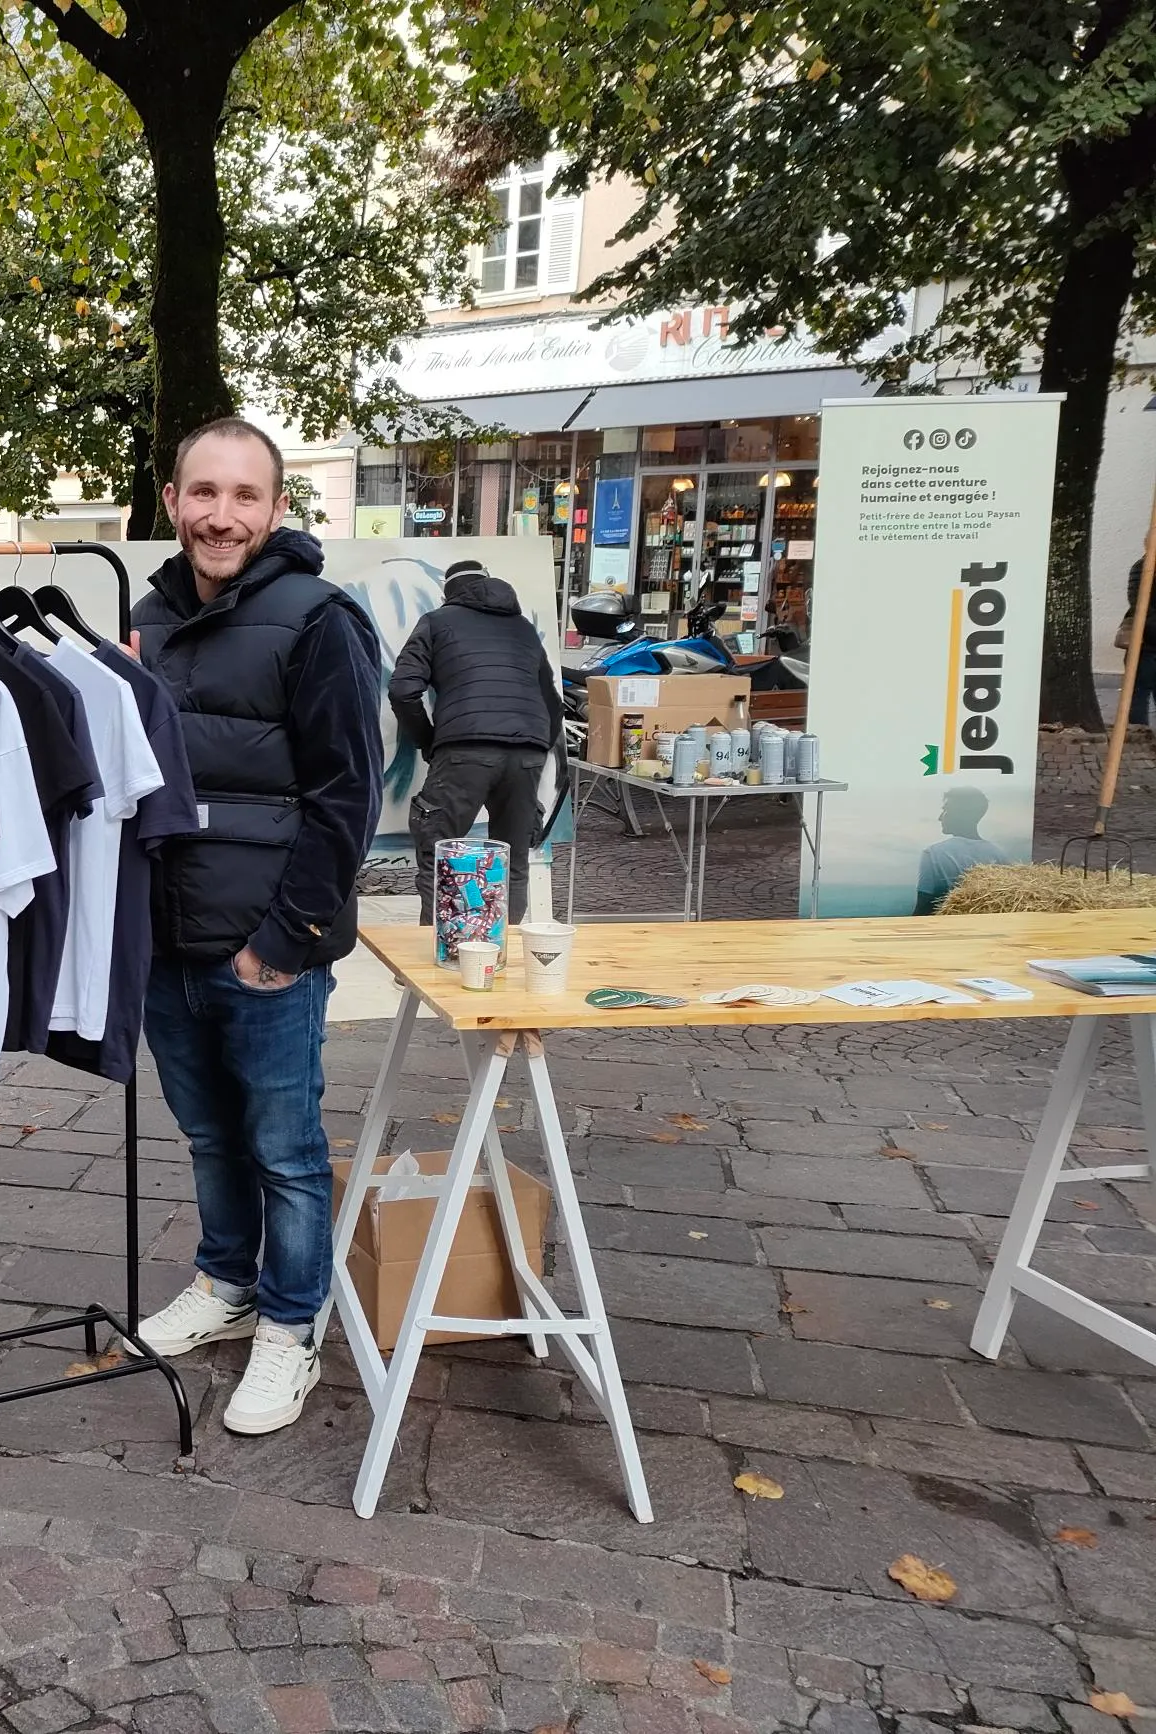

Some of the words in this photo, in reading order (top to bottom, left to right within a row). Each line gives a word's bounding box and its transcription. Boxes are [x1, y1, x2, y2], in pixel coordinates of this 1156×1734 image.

[540, 336, 593, 361] Entier
[862, 464, 960, 477] Rejoignez-nous
[861, 479, 891, 489] dans
[894, 479, 927, 488] cette
[928, 478, 988, 488] aventure
[860, 492, 917, 503] humaine
[919, 492, 931, 502] et
[933, 491, 989, 504] engagée
[859, 512, 911, 521] Petit-frère
[913, 511, 925, 520] de
[927, 511, 962, 519] Jeanot
[965, 510, 984, 519] Lou
[987, 510, 1021, 521] Paysan
[859, 523, 868, 531] la
[871, 523, 920, 531] rencontre
[922, 522, 949, 530] entre
[951, 522, 960, 530] la
[963, 521, 992, 530] mode
[858, 533, 869, 542] et
[871, 533, 879, 541] le
[882, 532, 929, 541] vêtement
[931, 532, 944, 540] de
[946, 531, 979, 540] travail
[959, 561, 1015, 775] jeanot
[715, 750, 731, 761] 94
